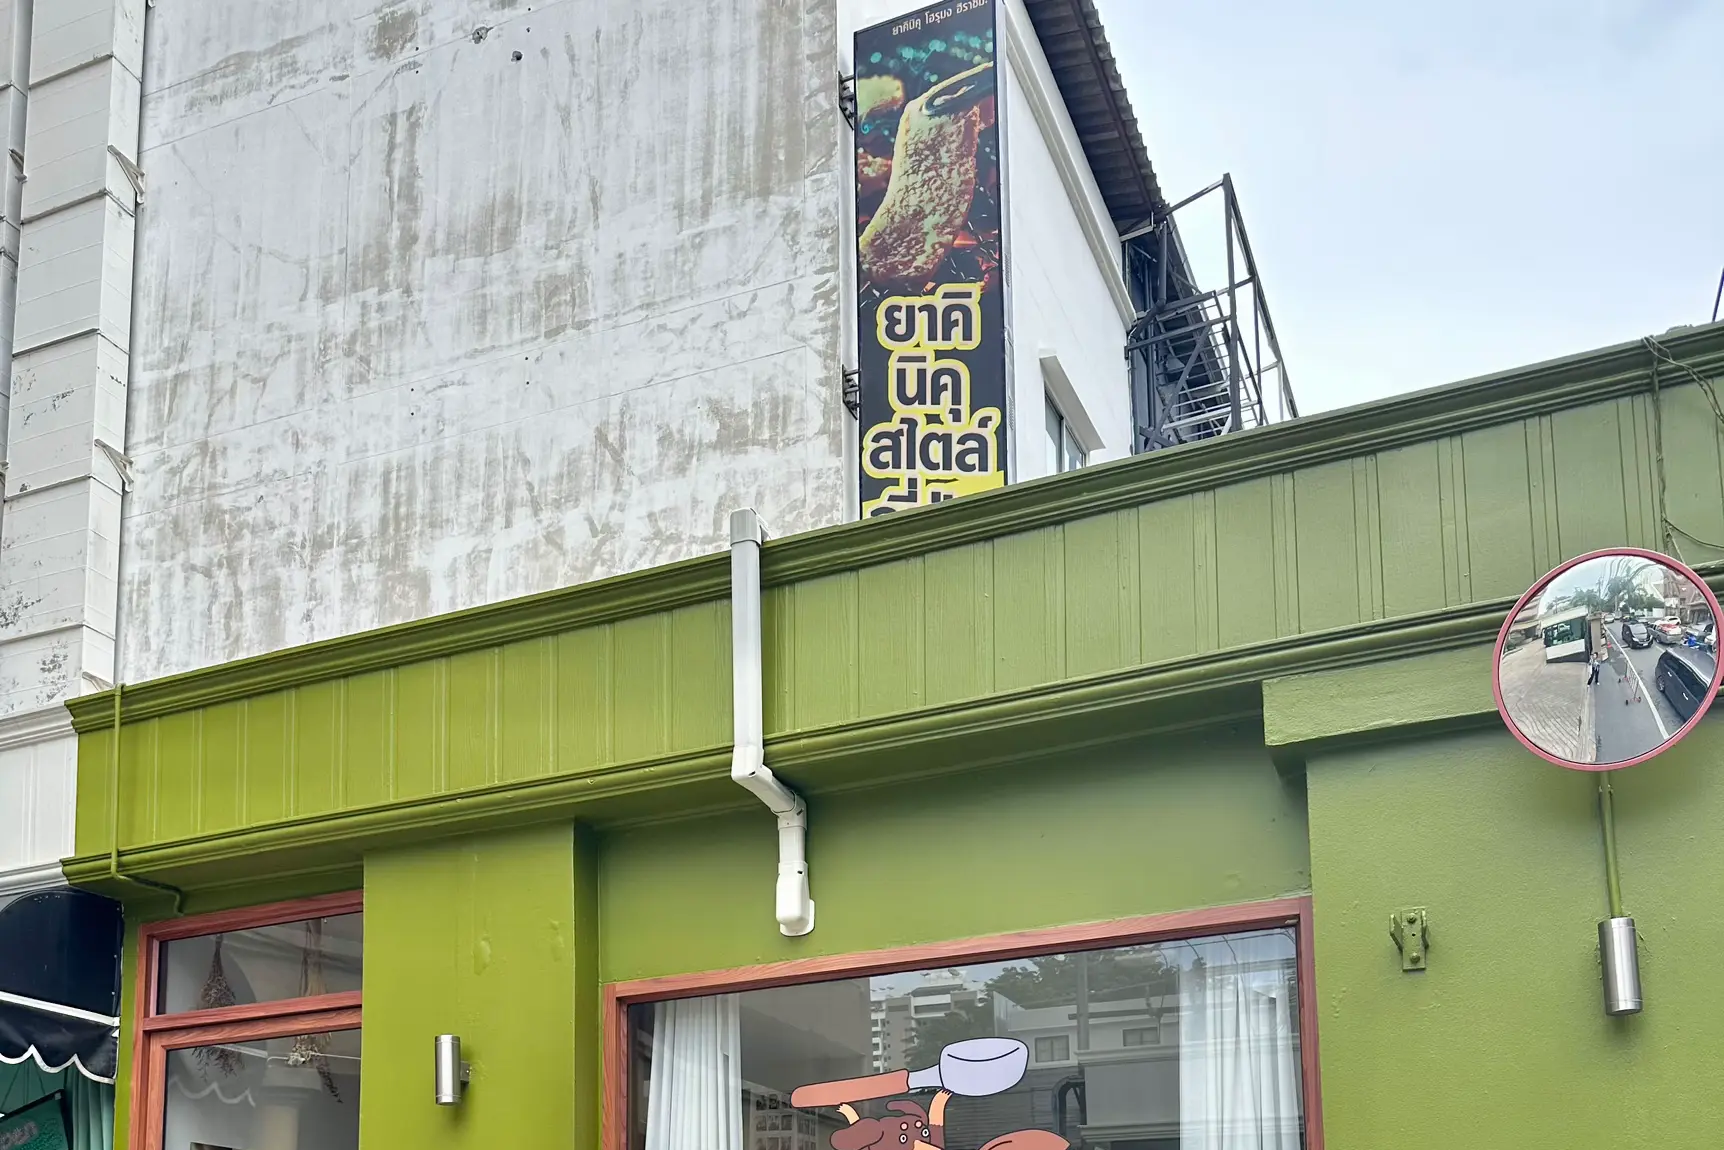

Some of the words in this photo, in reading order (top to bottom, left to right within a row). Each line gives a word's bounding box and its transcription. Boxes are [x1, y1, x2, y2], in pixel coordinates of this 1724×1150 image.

[884, 291, 973, 343] ยาคิ
[896, 355, 962, 423] นิคุ
[869, 415, 993, 473] สไตล์
